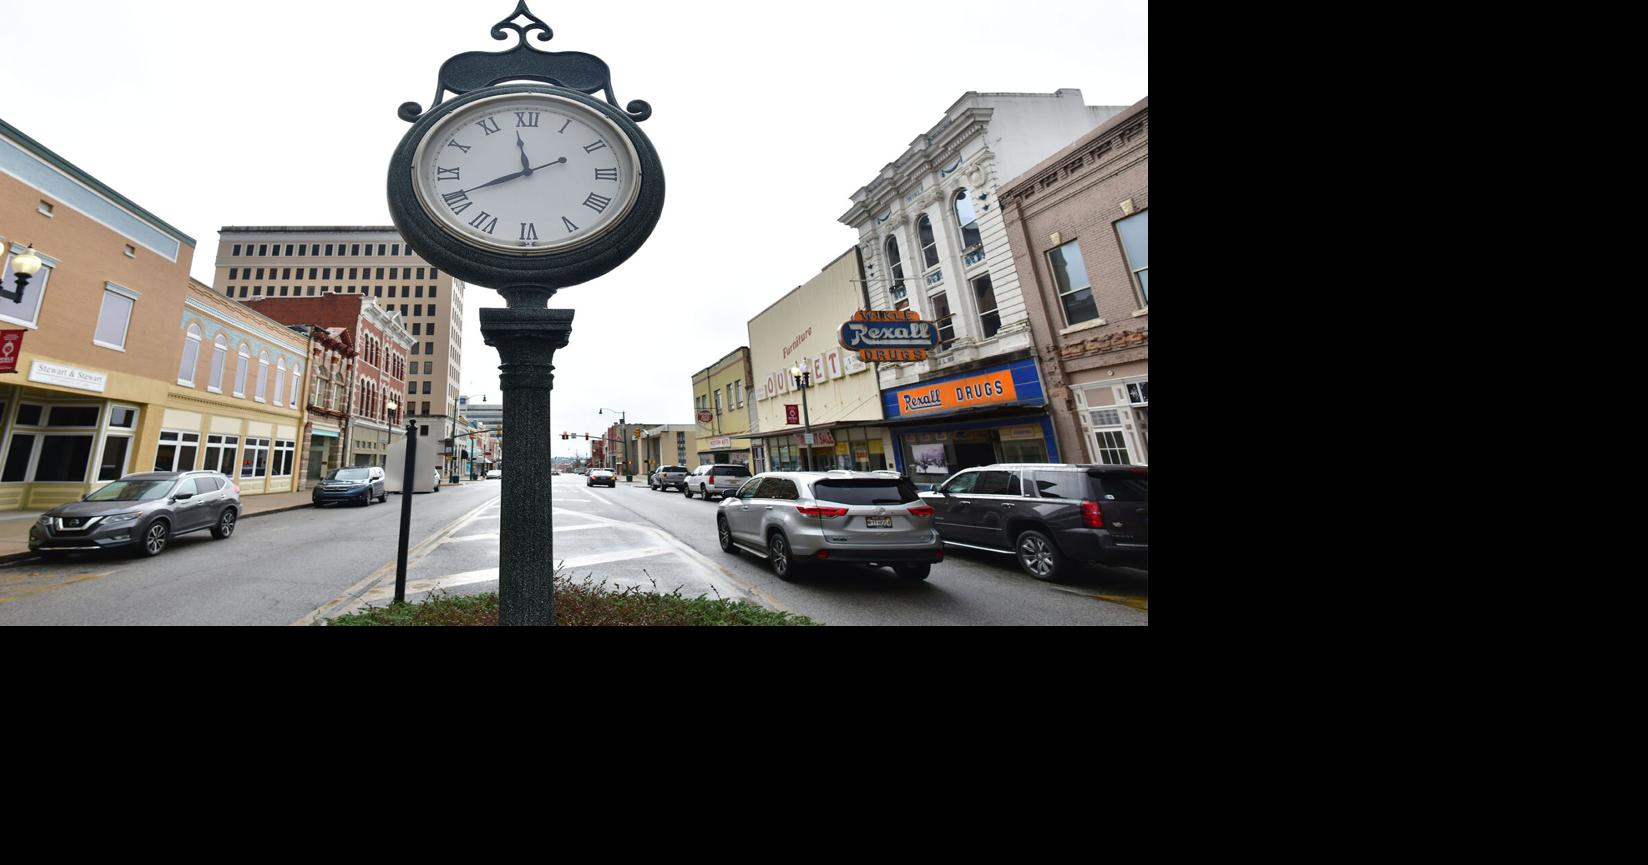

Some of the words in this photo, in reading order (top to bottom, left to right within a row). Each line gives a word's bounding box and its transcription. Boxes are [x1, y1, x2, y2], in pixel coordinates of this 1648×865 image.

[475, 117, 501, 135] XI
[514, 112, 540, 127] XII
[558, 120, 571, 134] I
[448, 139, 471, 153] X
[583, 139, 607, 153] II
[437, 166, 459, 181] IX
[594, 167, 617, 181] III
[442, 189, 473, 215] VIII
[582, 192, 611, 214] IIII
[468, 211, 498, 234] VII
[561, 216, 579, 233] V
[519, 223, 538, 240] VI
[848, 322, 931, 345] Rexall
[782, 327, 812, 359] Furniture
[864, 350, 923, 361] DRUGS
[38, 364, 67, 376] Stewart
[78, 371, 103, 382] Stewart
[767, 352, 837, 394] OUTET
[903, 389, 942, 411] Rexall
[955, 380, 1004, 401] DRUGS
